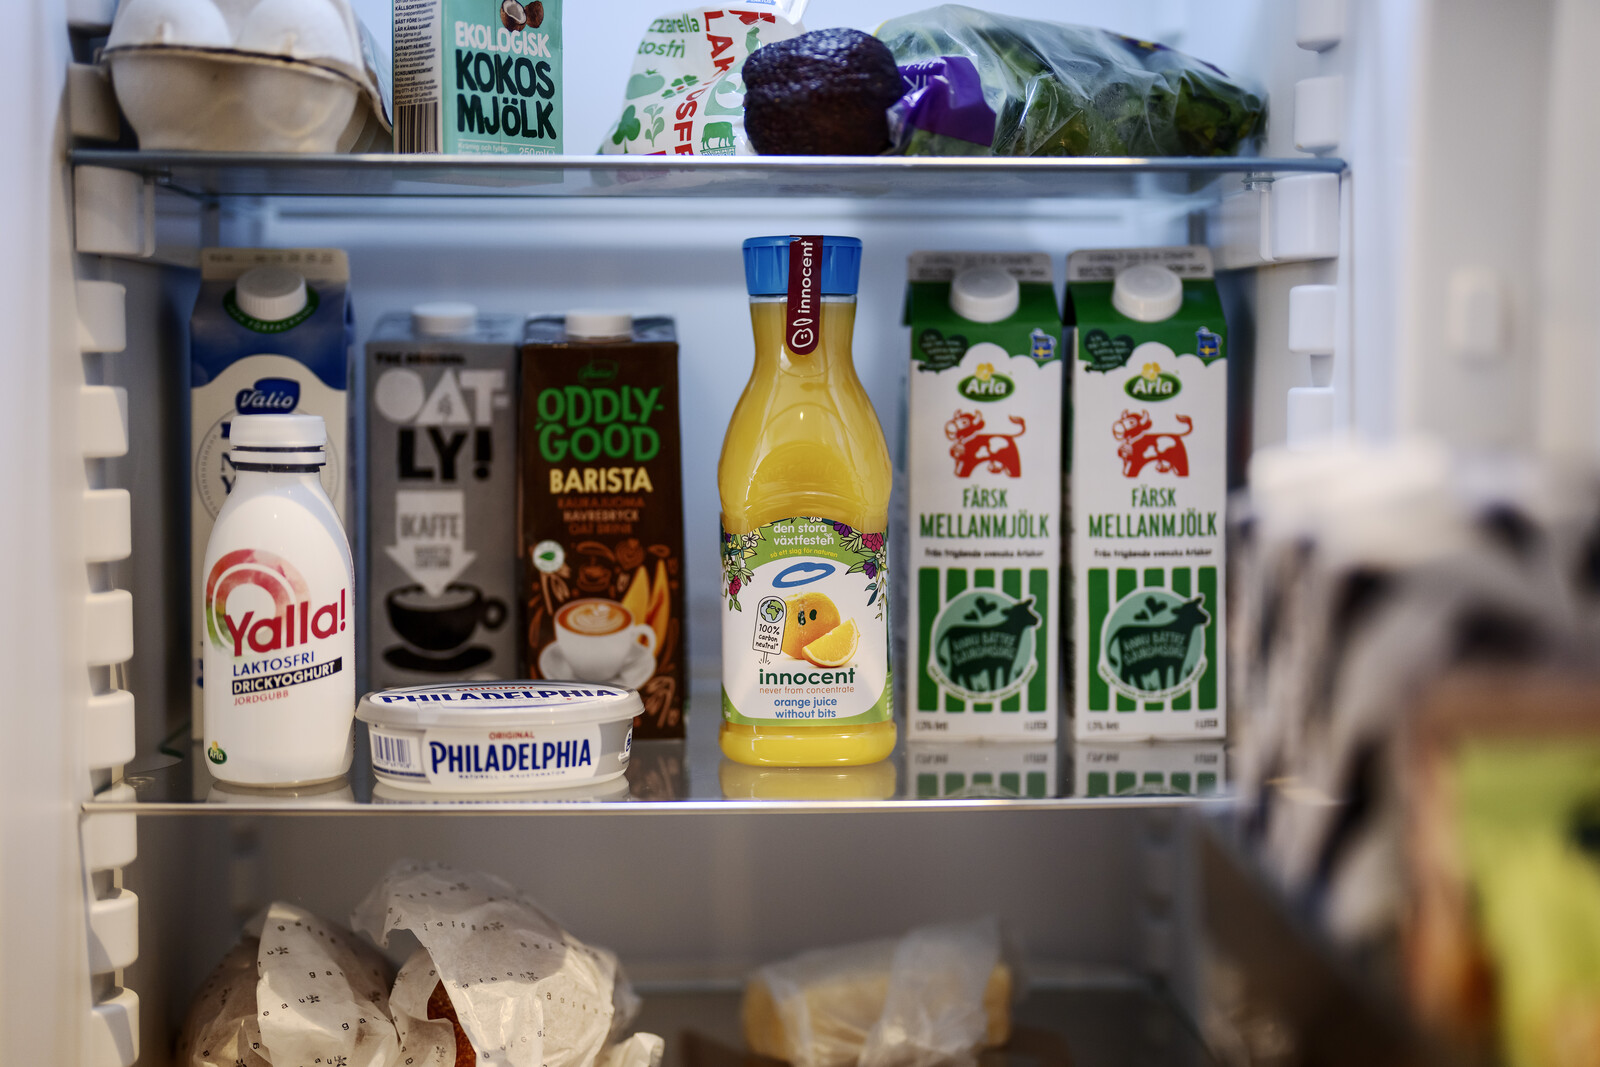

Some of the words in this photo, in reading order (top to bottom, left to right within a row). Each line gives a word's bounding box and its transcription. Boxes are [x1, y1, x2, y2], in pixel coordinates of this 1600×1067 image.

[455, 21, 552, 58] EKOLOGISK
[455, 49, 555, 99] KOKOS
[457, 93, 556, 140] MJÖLK
[798, 241, 814, 314] innocent
[966, 377, 1006, 395] Arla
[1132, 376, 1173, 395] Arla
[239, 390, 295, 408] Valio
[398, 426, 492, 481] LY!
[537, 423, 660, 463] GOOD
[550, 466, 654, 494] BARISTA
[962, 484, 1008, 508] FÄRSK
[1132, 484, 1176, 507] FÄRSK
[773, 522, 794, 533] den
[798, 524, 827, 533] stora
[920, 509, 1049, 538] MELLANMJÖLK
[1088, 508, 1217, 538] MELLANMJÖLK
[773, 534, 834, 546] växtfesten
[814, 549, 838, 558] naturen
[224, 588, 346, 657] Yalla!
[760, 624, 780, 635] 100%
[233, 650, 315, 677] LAKTOSFRI
[234, 662, 336, 694] DRICKYOGHURT
[759, 668, 855, 685] innocent
[234, 690, 289, 706] JORDGUBB
[378, 690, 619, 704] PHILADELPHIA
[784, 686, 804, 694] from
[806, 686, 854, 694] concentrate
[774, 698, 811, 708] orange
[813, 697, 838, 708] juice
[775, 709, 815, 718] without
[818, 708, 836, 718] bits
[489, 732, 535, 740] ORIGINAL
[210, 750, 224, 761] Arla
[429, 739, 592, 774] PHILADELPHIA
